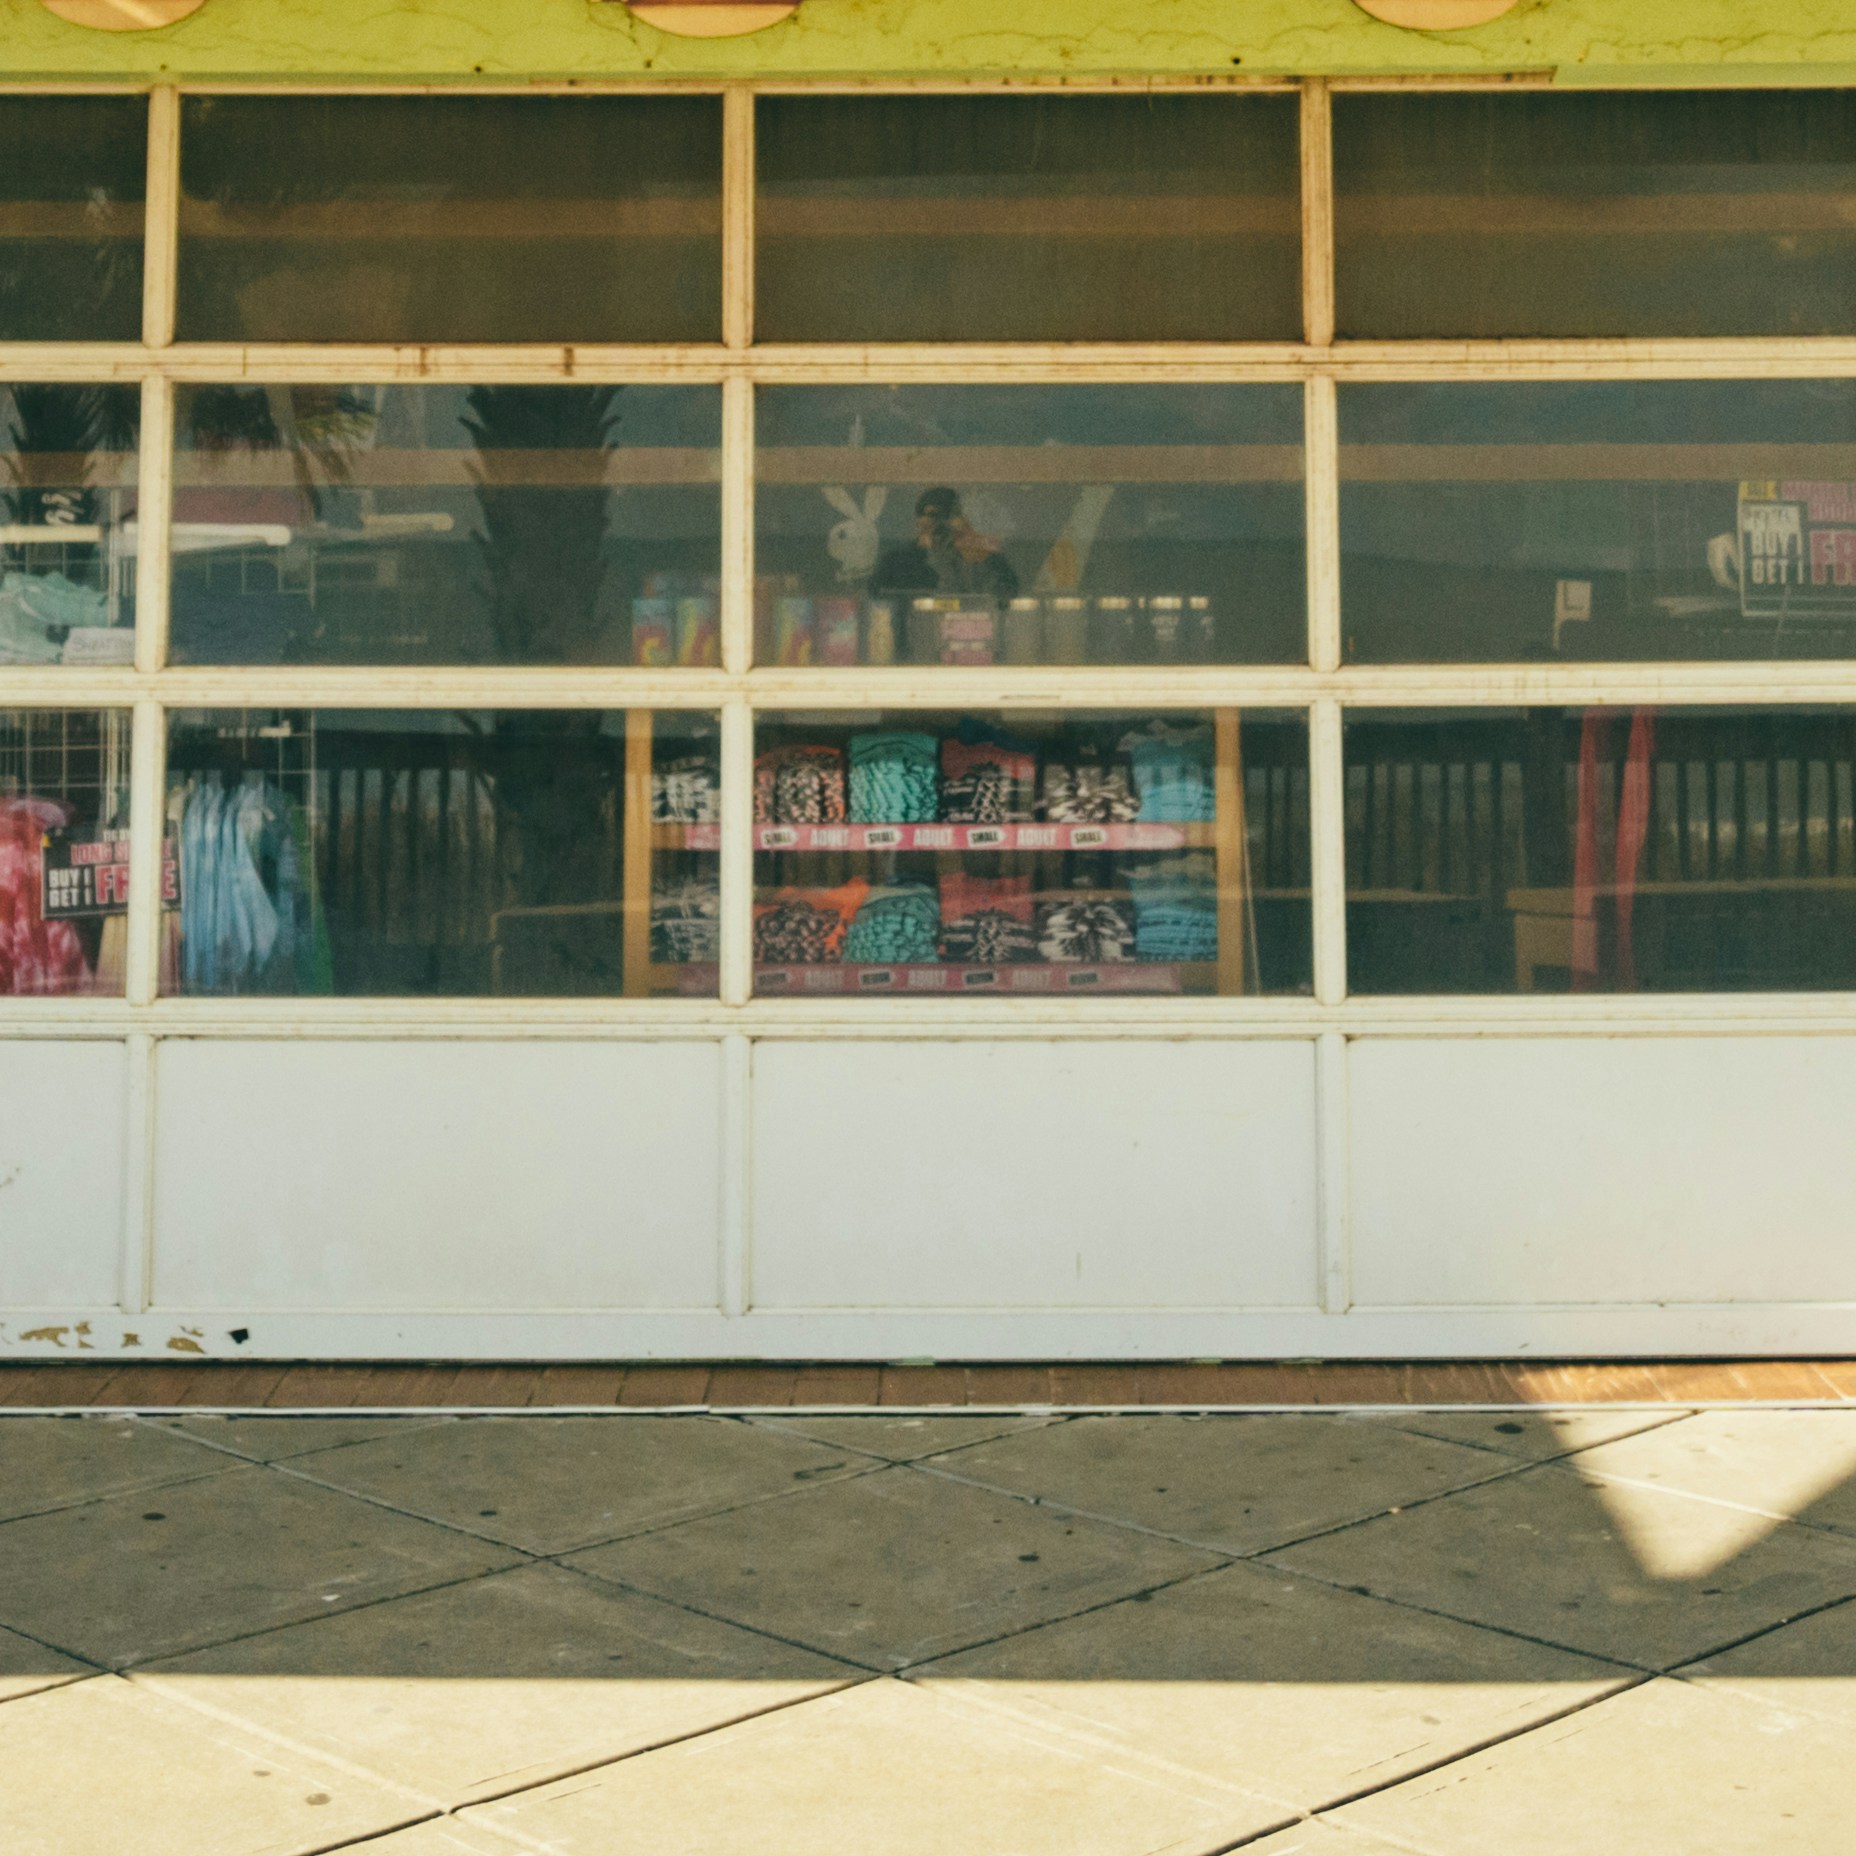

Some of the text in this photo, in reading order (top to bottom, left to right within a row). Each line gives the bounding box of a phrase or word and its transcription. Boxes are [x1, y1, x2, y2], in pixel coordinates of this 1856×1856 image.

[48, 868, 80, 889] BUY
[94, 859, 178, 905] FRE
[48, 888, 80, 909] GET
